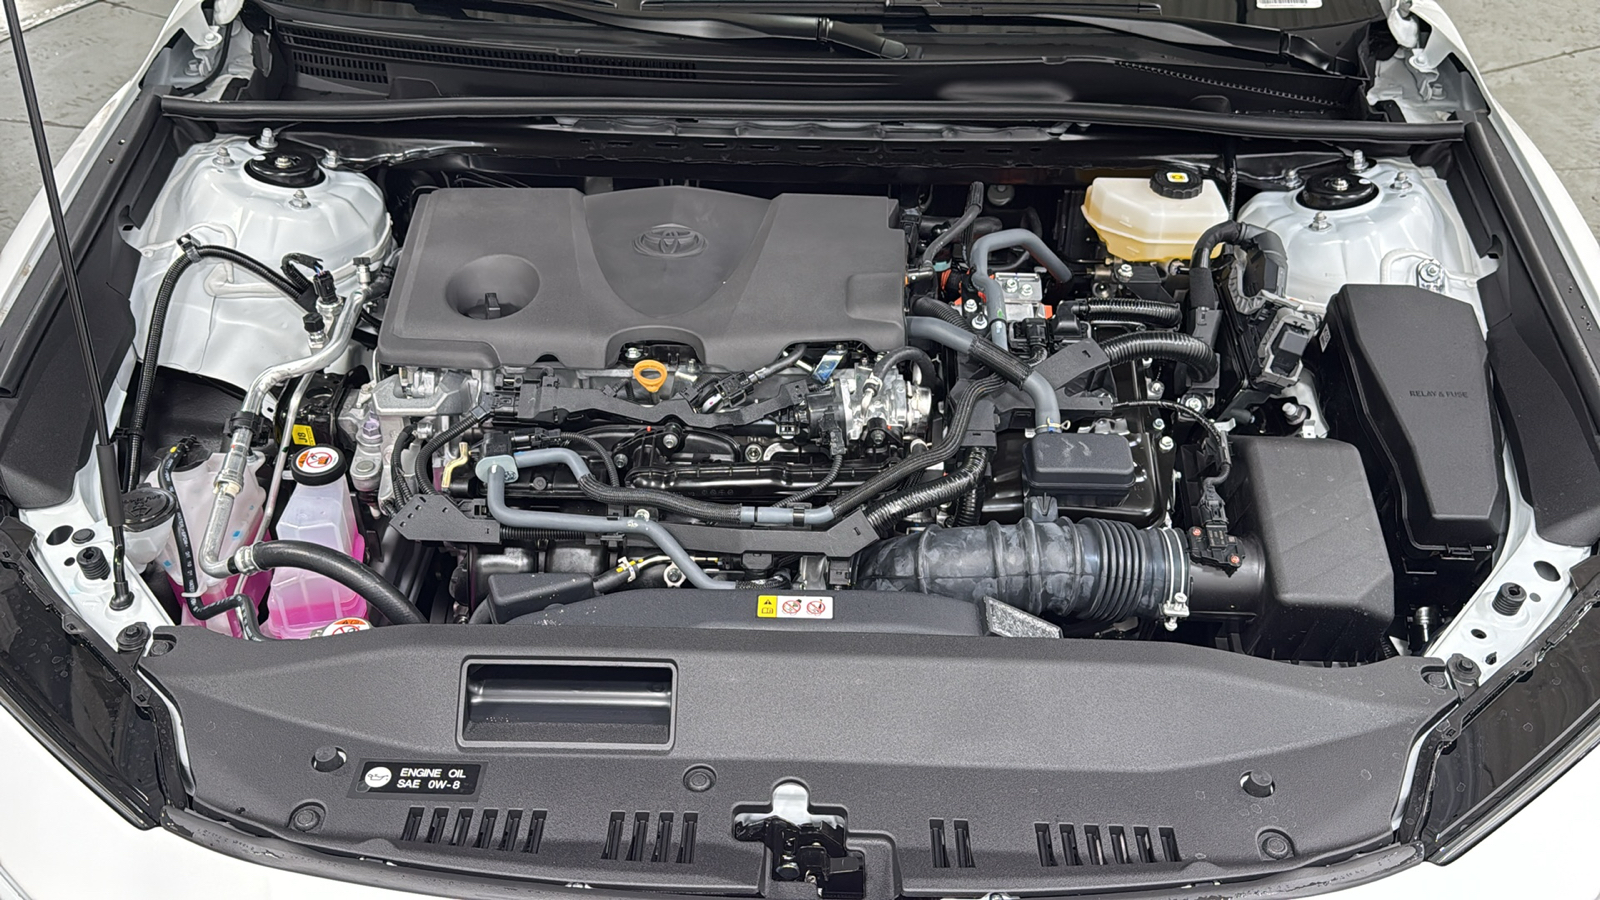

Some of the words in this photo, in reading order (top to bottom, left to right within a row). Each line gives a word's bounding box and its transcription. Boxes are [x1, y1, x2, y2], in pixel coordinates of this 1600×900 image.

[400, 767, 442, 778] ENGINE
[448, 769, 467, 778] OIL
[396, 779, 421, 788] SAE
[428, 780, 461, 789] 0W-8
